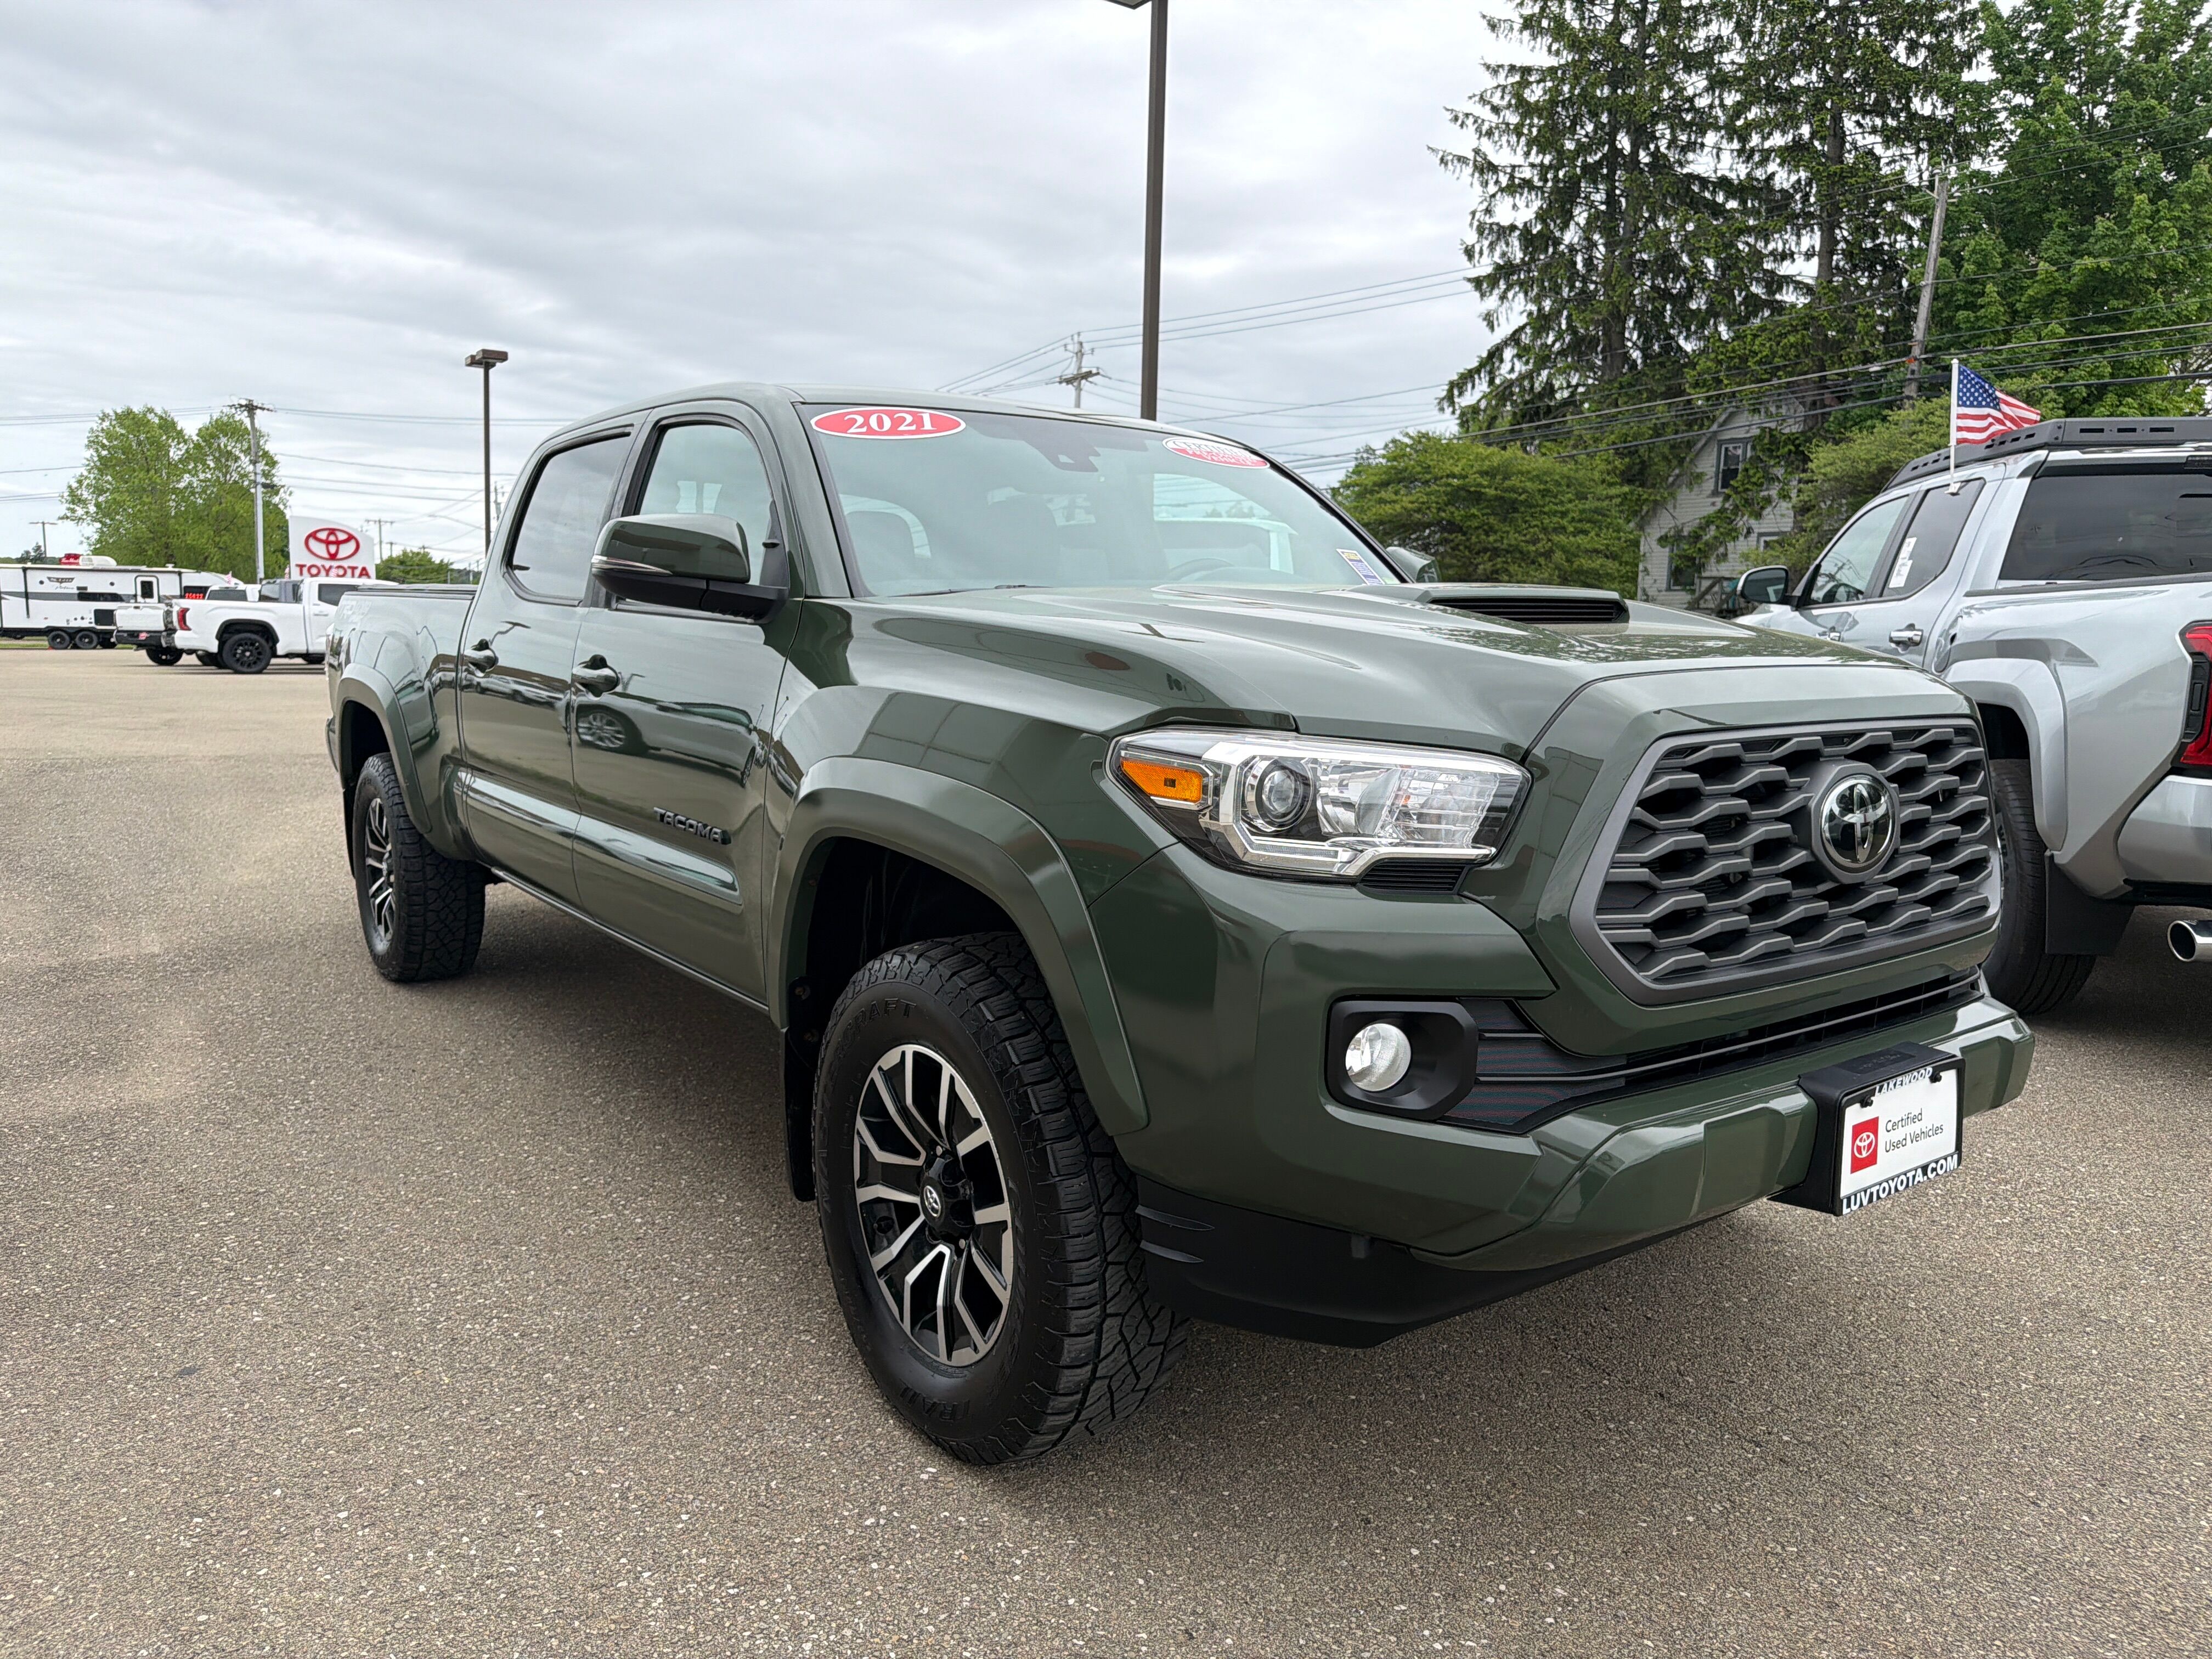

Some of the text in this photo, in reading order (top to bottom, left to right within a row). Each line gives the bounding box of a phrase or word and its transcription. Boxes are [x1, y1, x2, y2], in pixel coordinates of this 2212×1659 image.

[844, 413, 937, 433] 2021
[295, 563, 371, 579] TOYOTA
[653, 806, 731, 845] TACOMA
[1875, 1067, 1933, 1097] LAKEWOOD
[1886, 1108, 1922, 1133] Certified
[1885, 1123, 1944, 1153] Used Vehicles
[1843, 1154, 1958, 1215] LUVTOYOTA.COM
